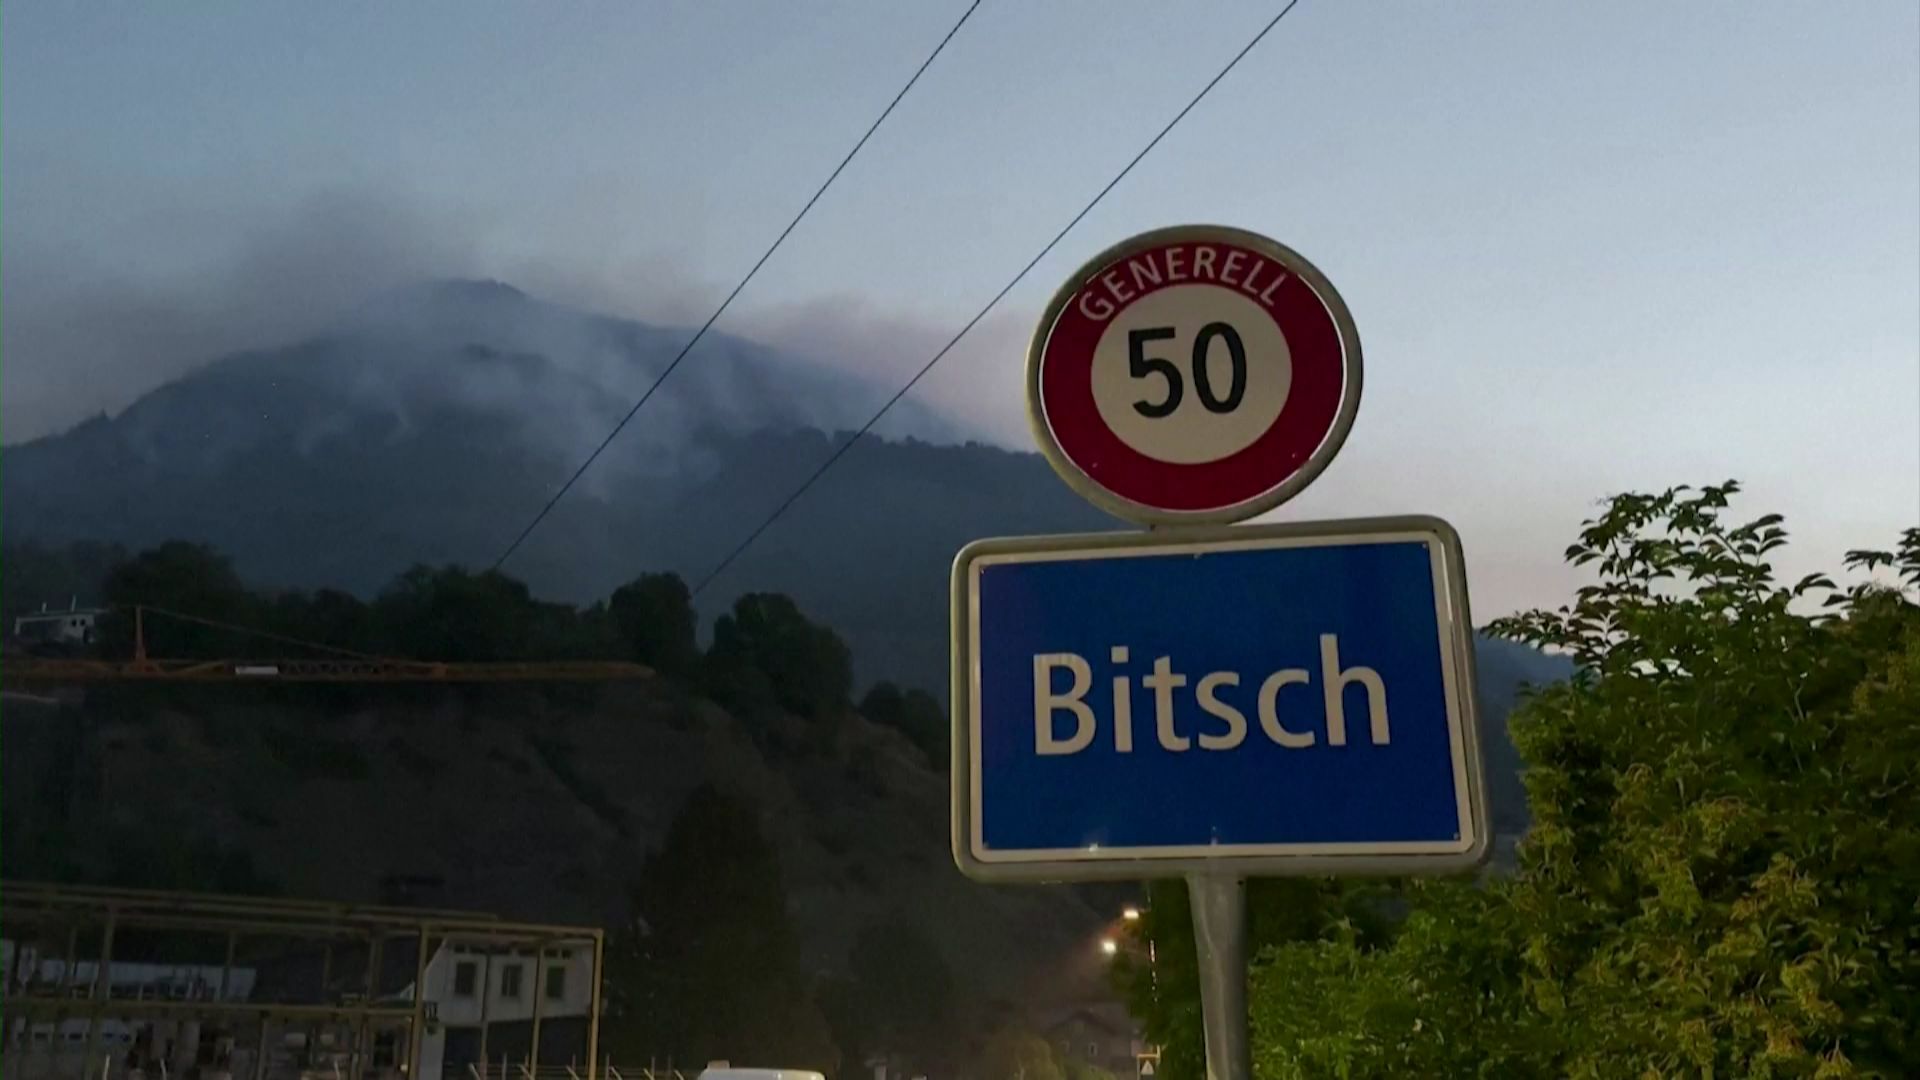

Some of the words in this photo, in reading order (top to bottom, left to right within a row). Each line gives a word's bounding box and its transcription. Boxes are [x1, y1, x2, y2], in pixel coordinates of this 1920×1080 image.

[1079, 246, 1288, 321] GENERELL
[1127, 321, 1247, 418] 50
[1032, 633, 1391, 755] Bitsch
